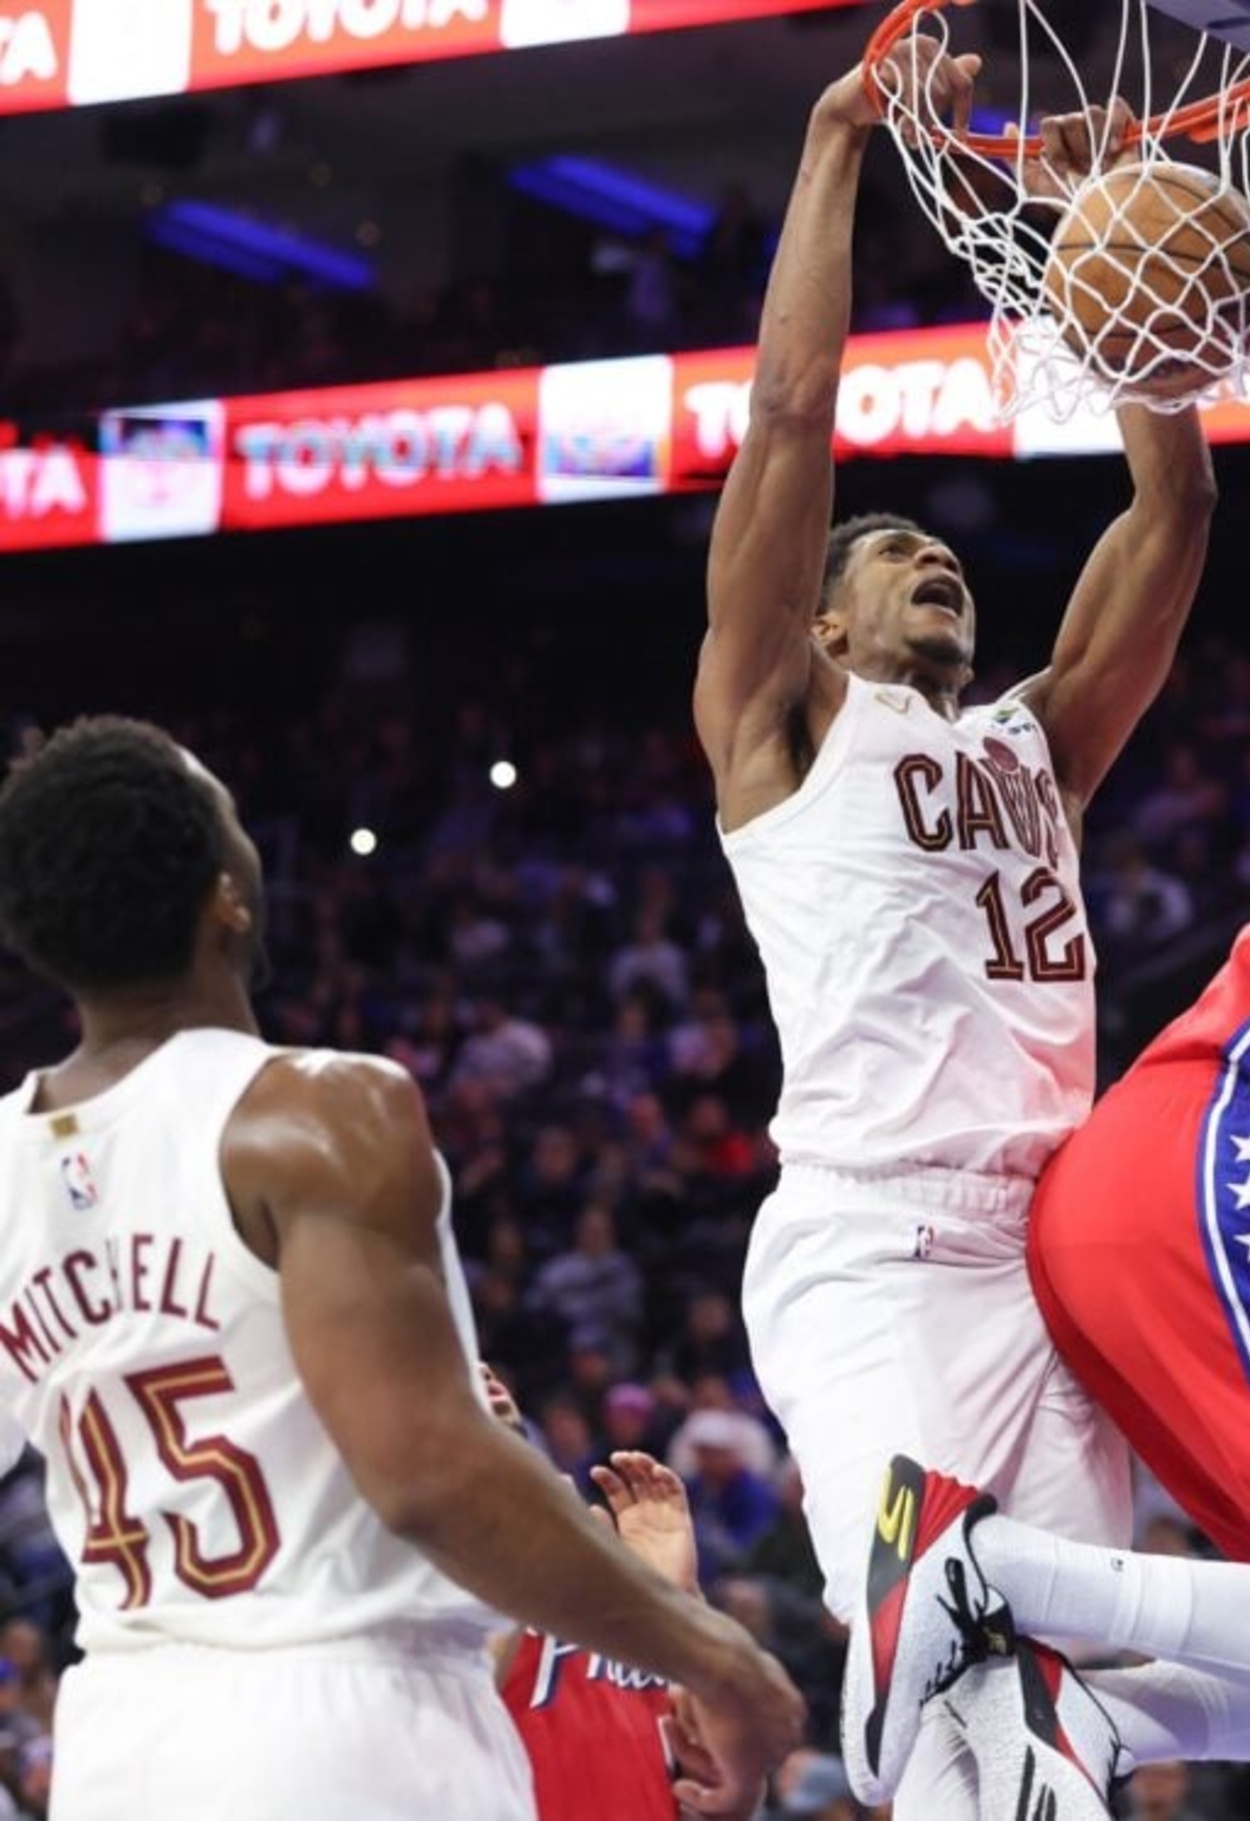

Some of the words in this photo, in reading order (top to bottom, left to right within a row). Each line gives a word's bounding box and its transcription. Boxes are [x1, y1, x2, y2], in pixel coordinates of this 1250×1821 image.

[235, 403, 523, 500] TOYOTA
[685, 356, 1000, 459] TOTA
[976, 866, 1085, 983] 12
[58, 1354, 282, 1612] 45
